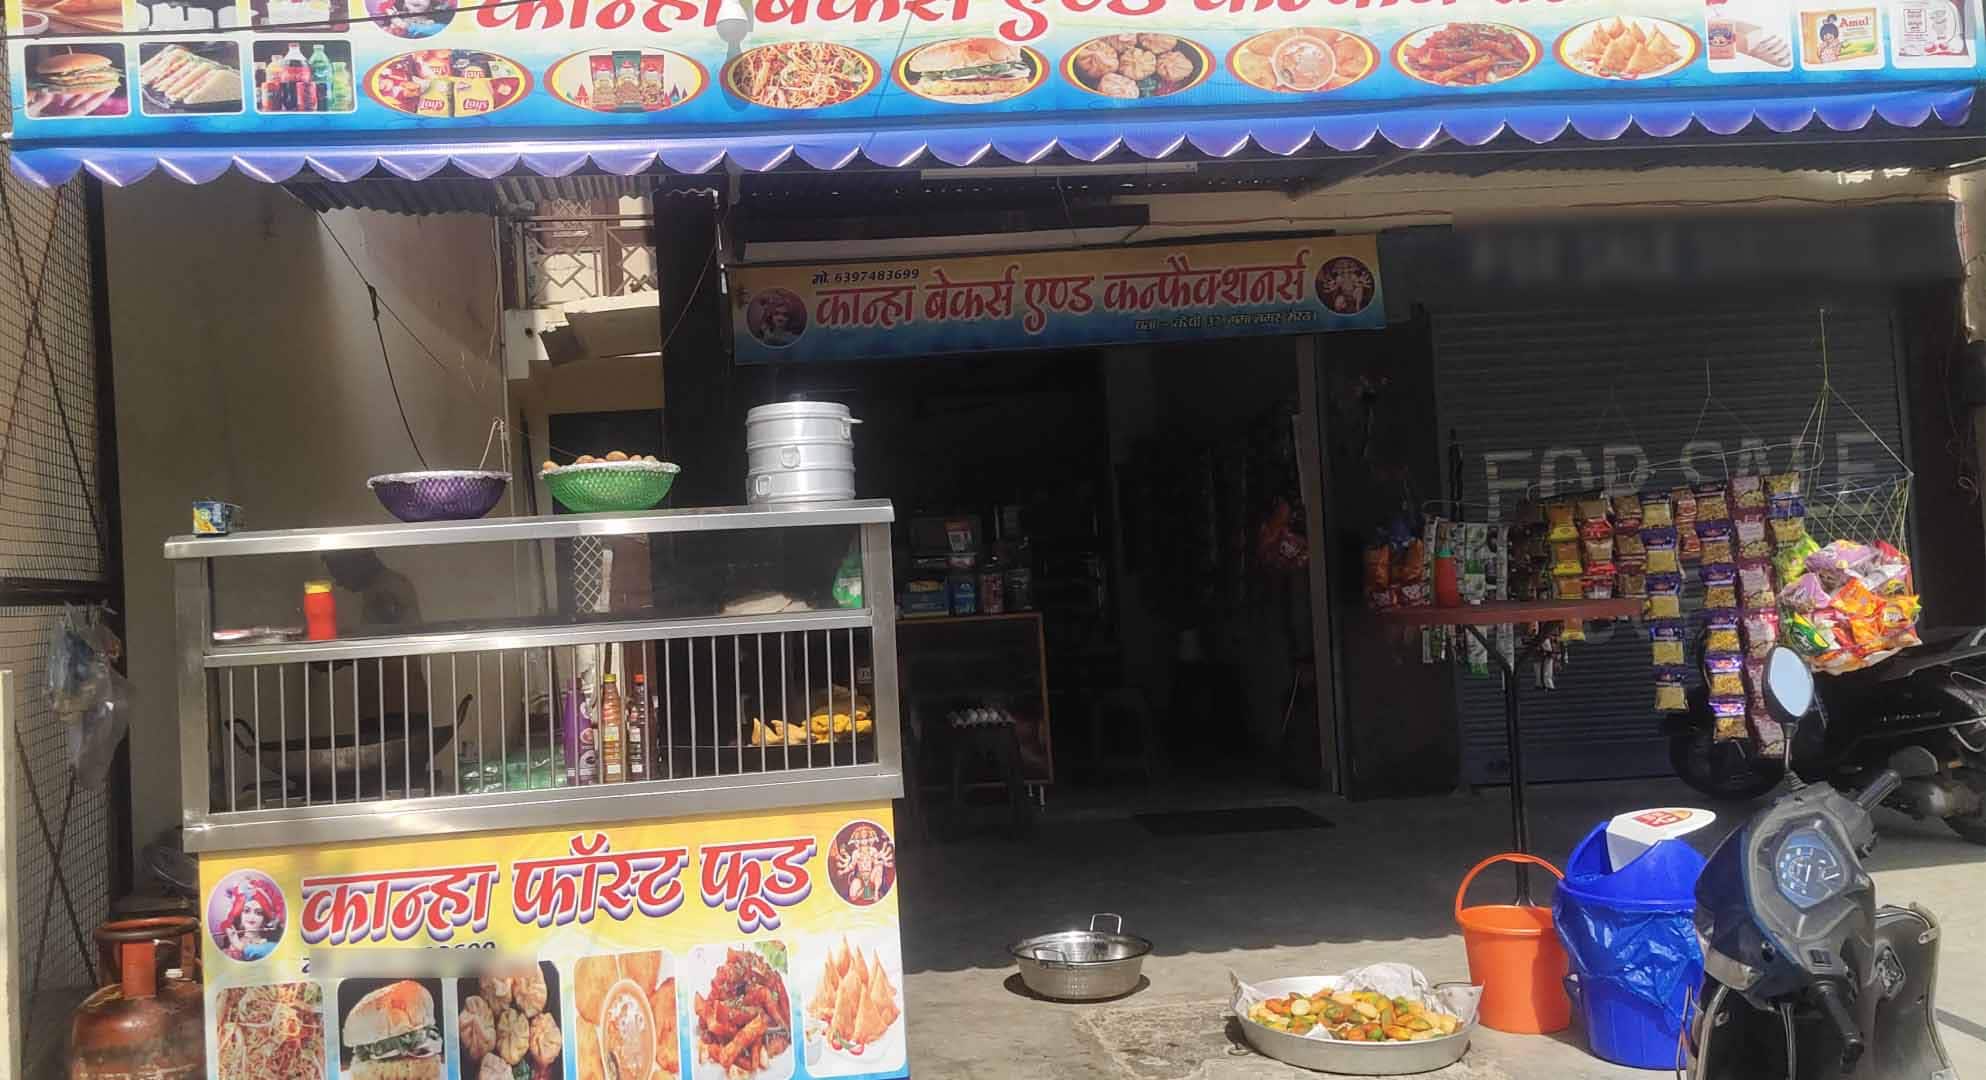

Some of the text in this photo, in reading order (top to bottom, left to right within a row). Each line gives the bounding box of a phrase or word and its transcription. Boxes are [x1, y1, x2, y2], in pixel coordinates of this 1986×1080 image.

[1839, 17, 1870, 29] Amul
[815, 284, 918, 326] कान्हा
[925, 265, 1020, 321] बेकर्स
[1023, 275, 1096, 333] एण्ड
[301, 832, 817, 943] कान्हा फॉस्ट फूड
